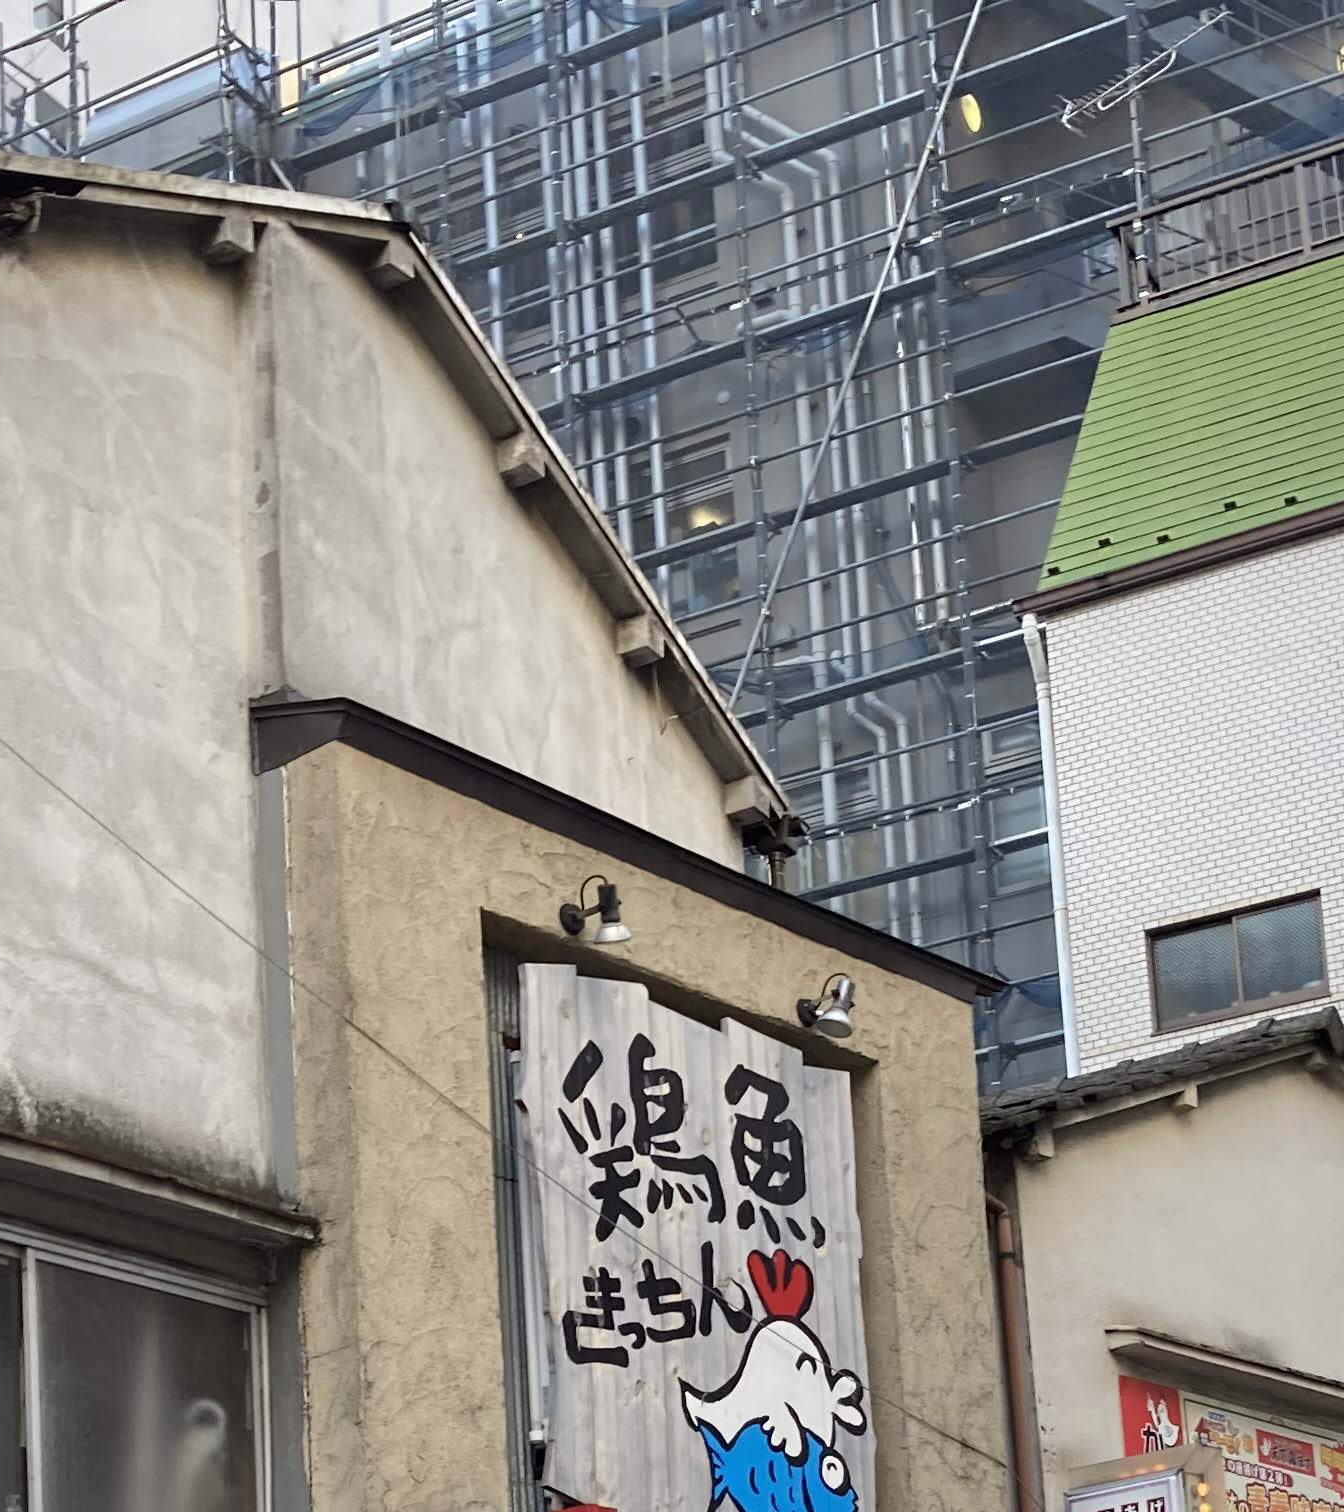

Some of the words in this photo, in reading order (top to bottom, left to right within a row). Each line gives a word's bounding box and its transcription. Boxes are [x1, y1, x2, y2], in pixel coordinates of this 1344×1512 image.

[559, 1033, 826, 1249] 鶏魚
[563, 1242, 753, 1368] きっちん
